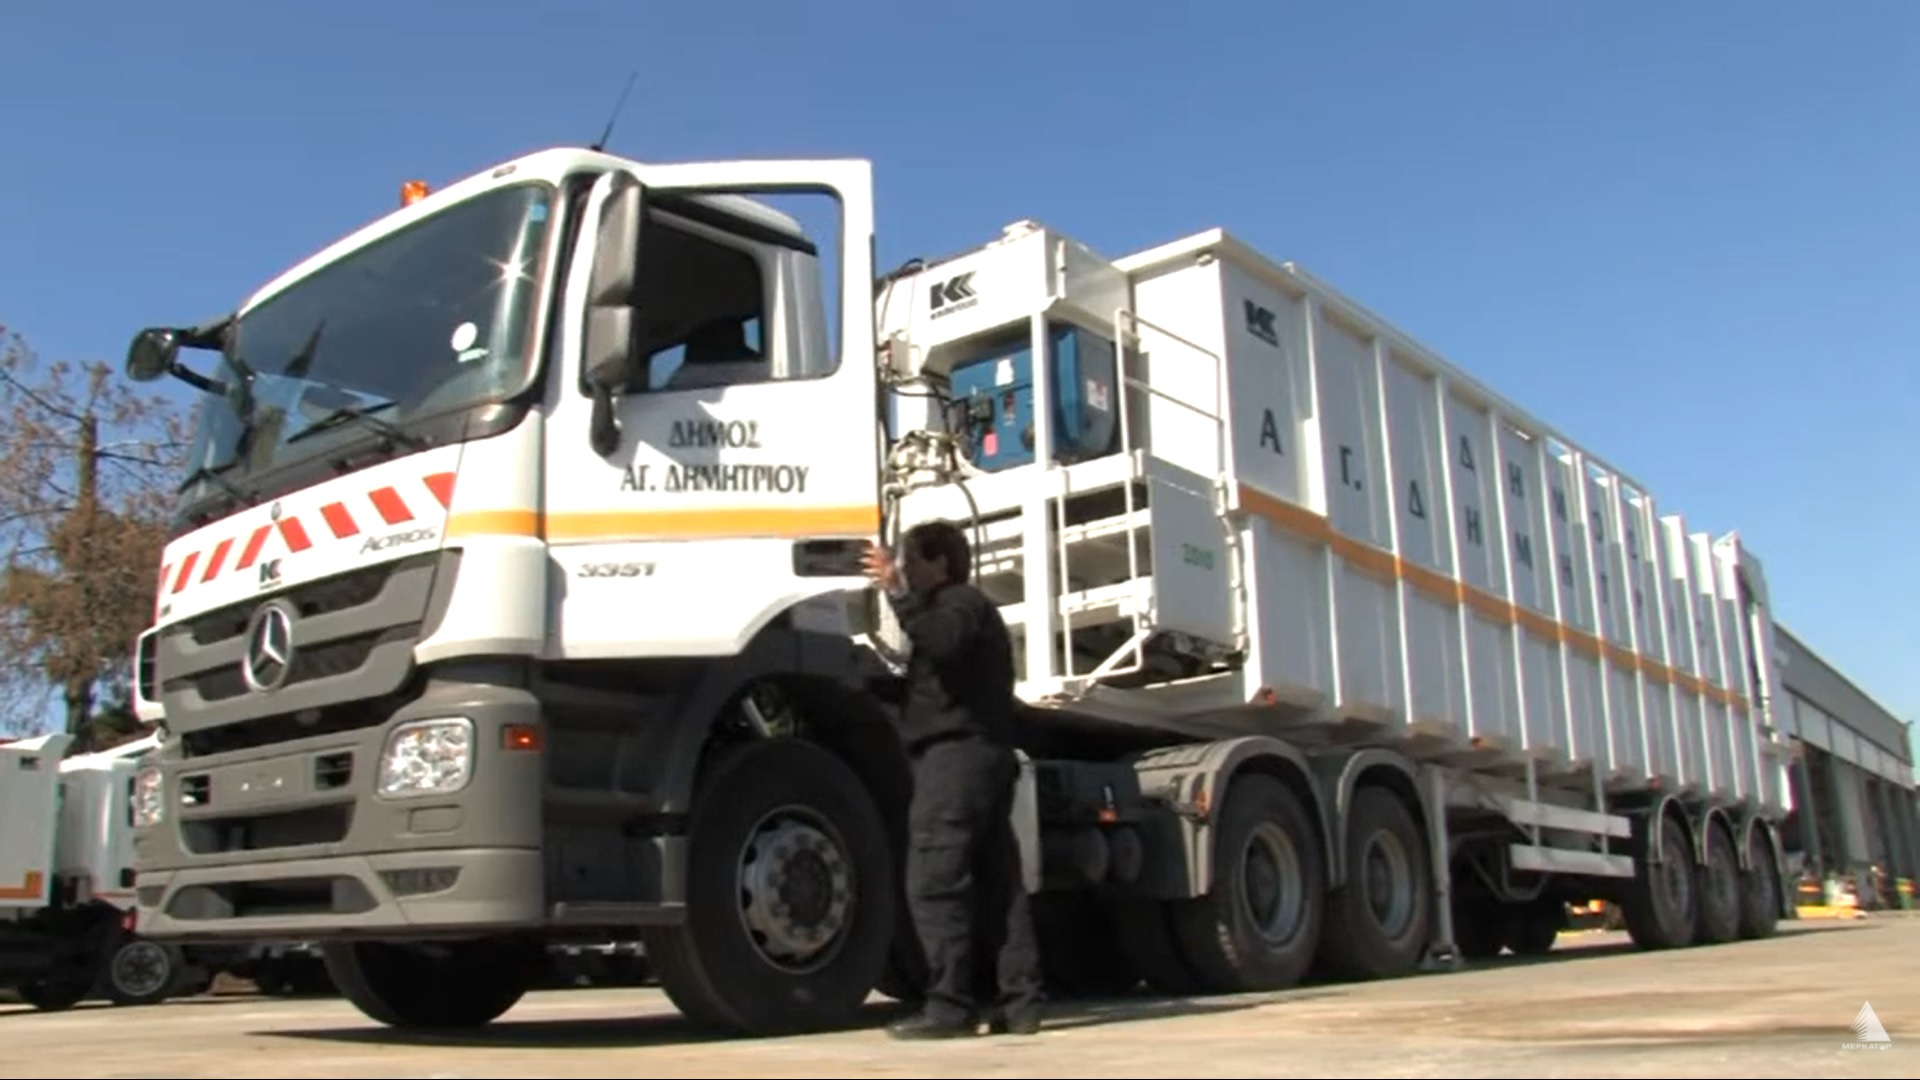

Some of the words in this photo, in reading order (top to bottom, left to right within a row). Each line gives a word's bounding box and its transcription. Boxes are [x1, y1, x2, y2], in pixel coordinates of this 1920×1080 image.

[668, 420, 762, 448] ΔΗΜΟΣ
[620, 465, 656, 491] ΑΓ.
[664, 464, 809, 493] ΔΗΜΗΤΡΙΟΥ
[577, 562, 656, 577] 3351
